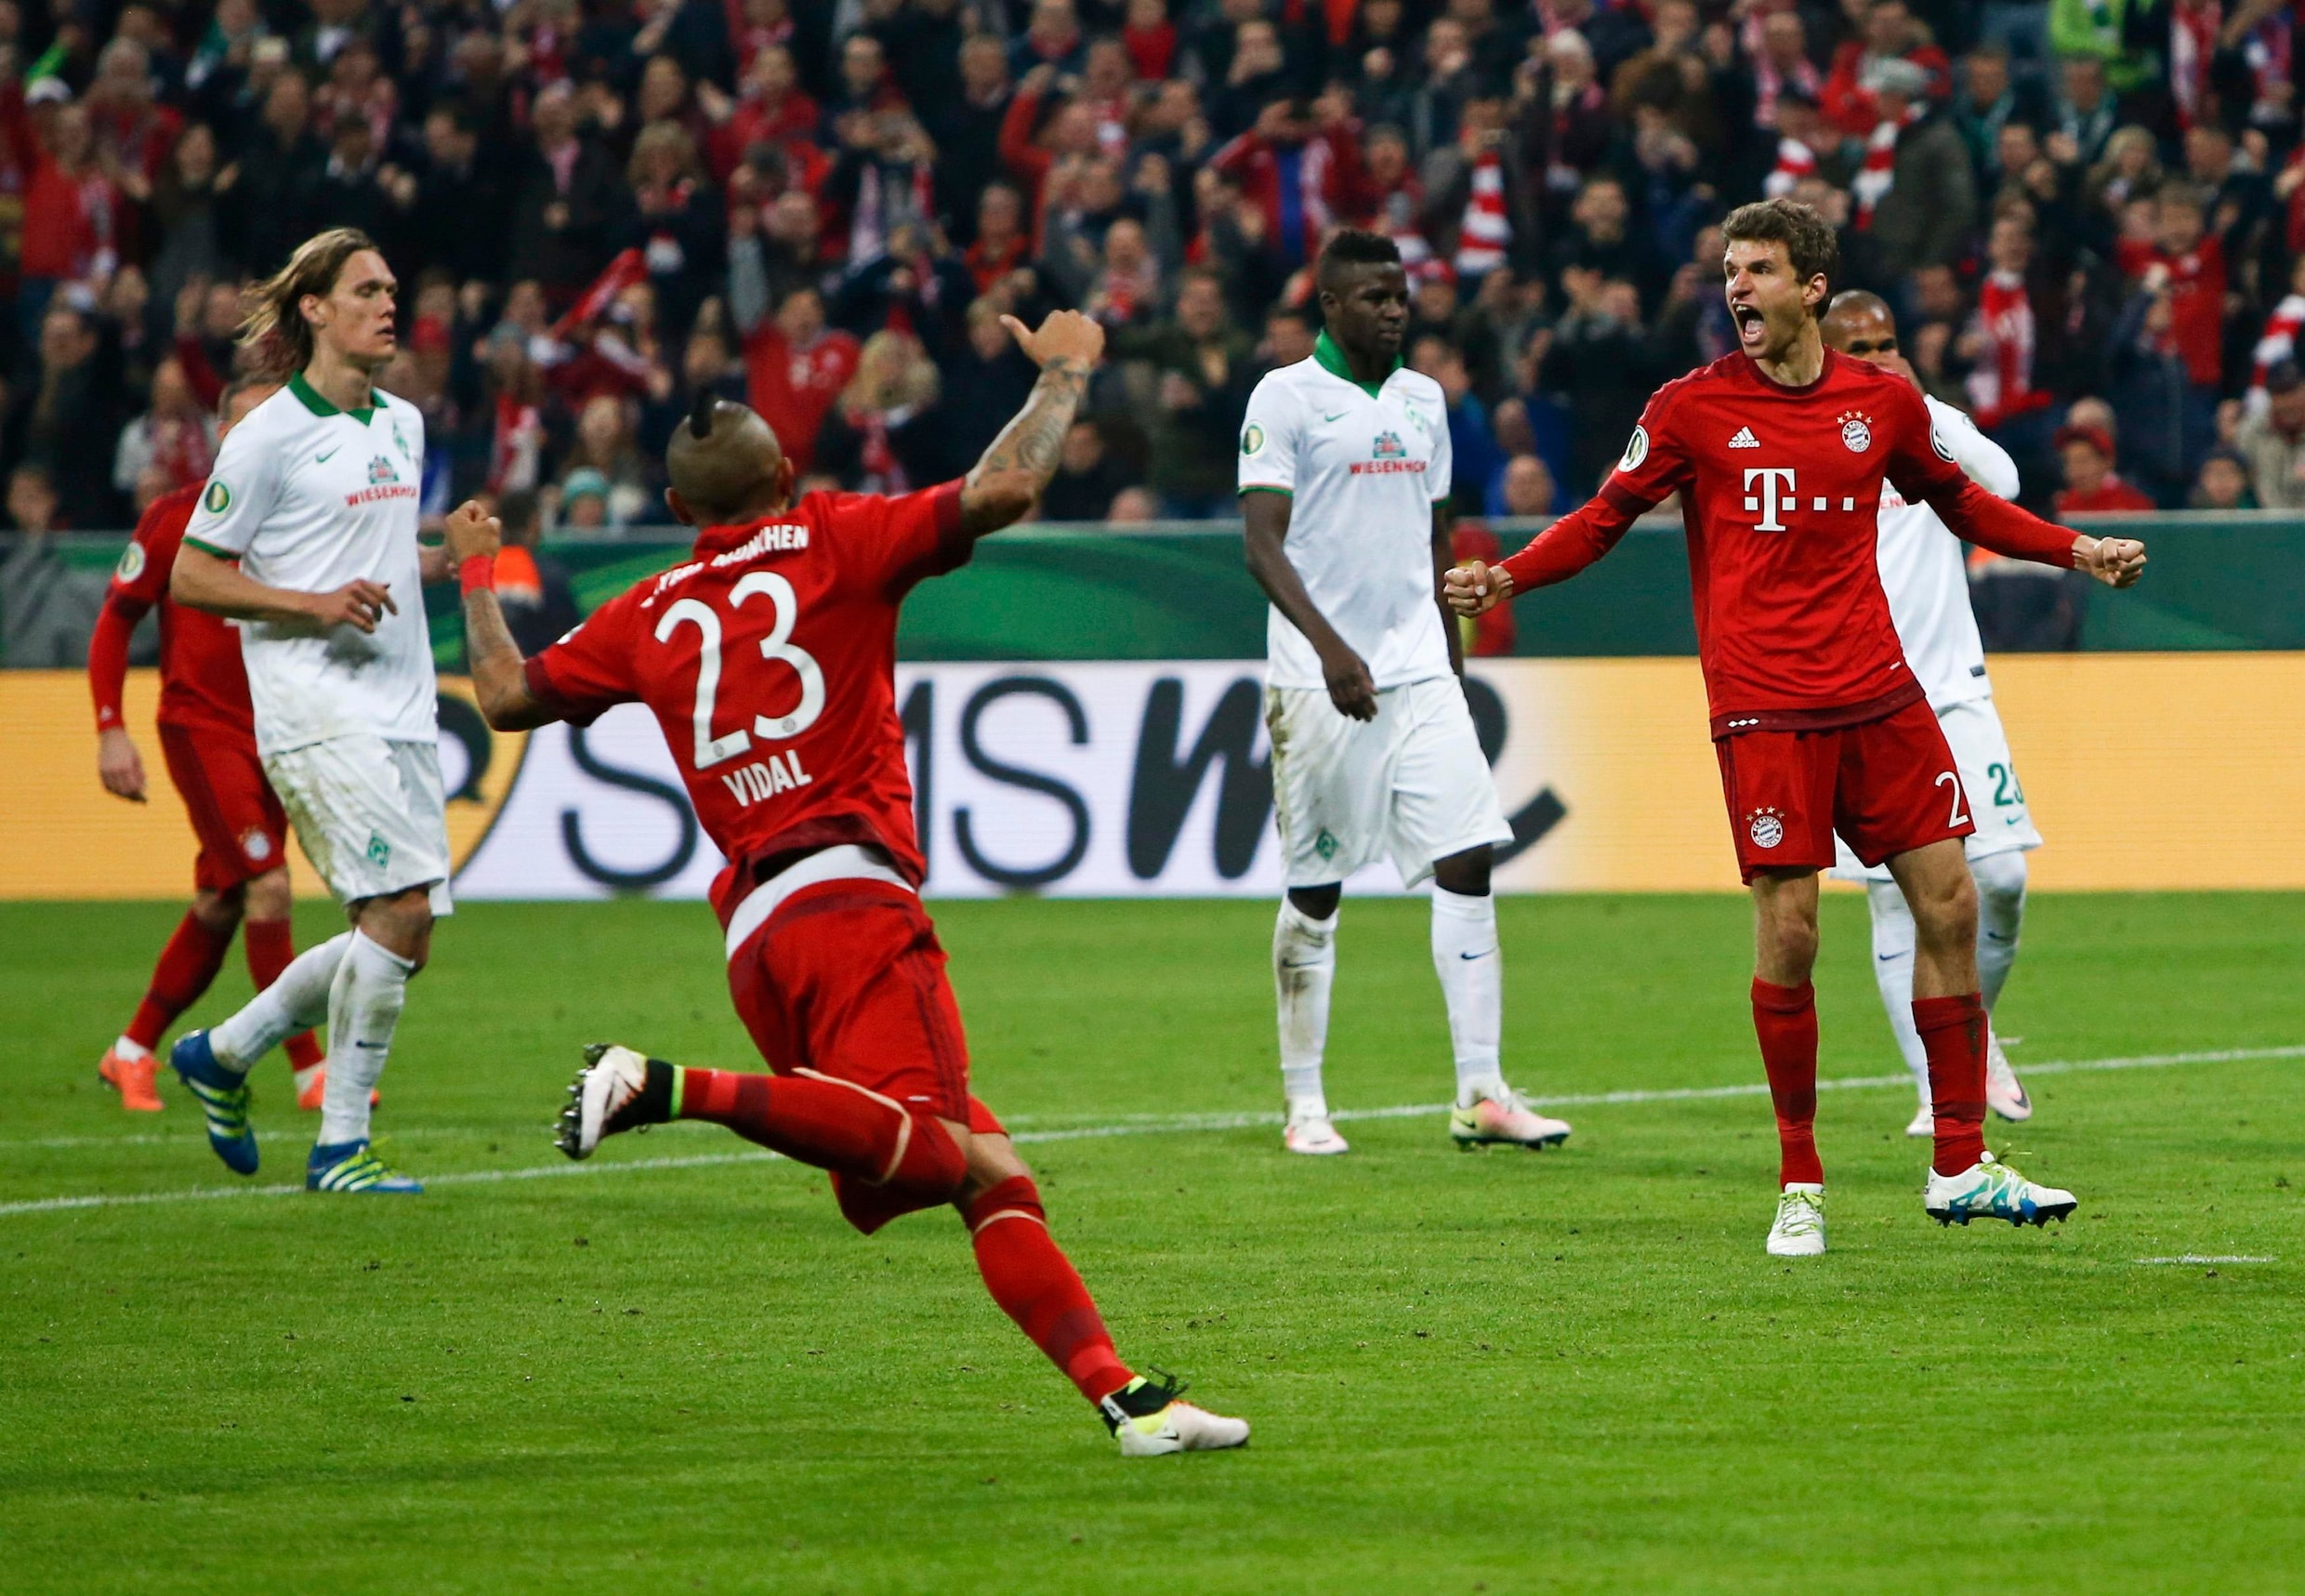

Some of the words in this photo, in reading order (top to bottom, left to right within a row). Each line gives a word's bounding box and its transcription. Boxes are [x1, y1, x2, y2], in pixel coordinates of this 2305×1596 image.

[710, 524, 810, 567] MNHEN
[654, 571, 826, 771] 23
[721, 749, 813, 807] VIDAL
